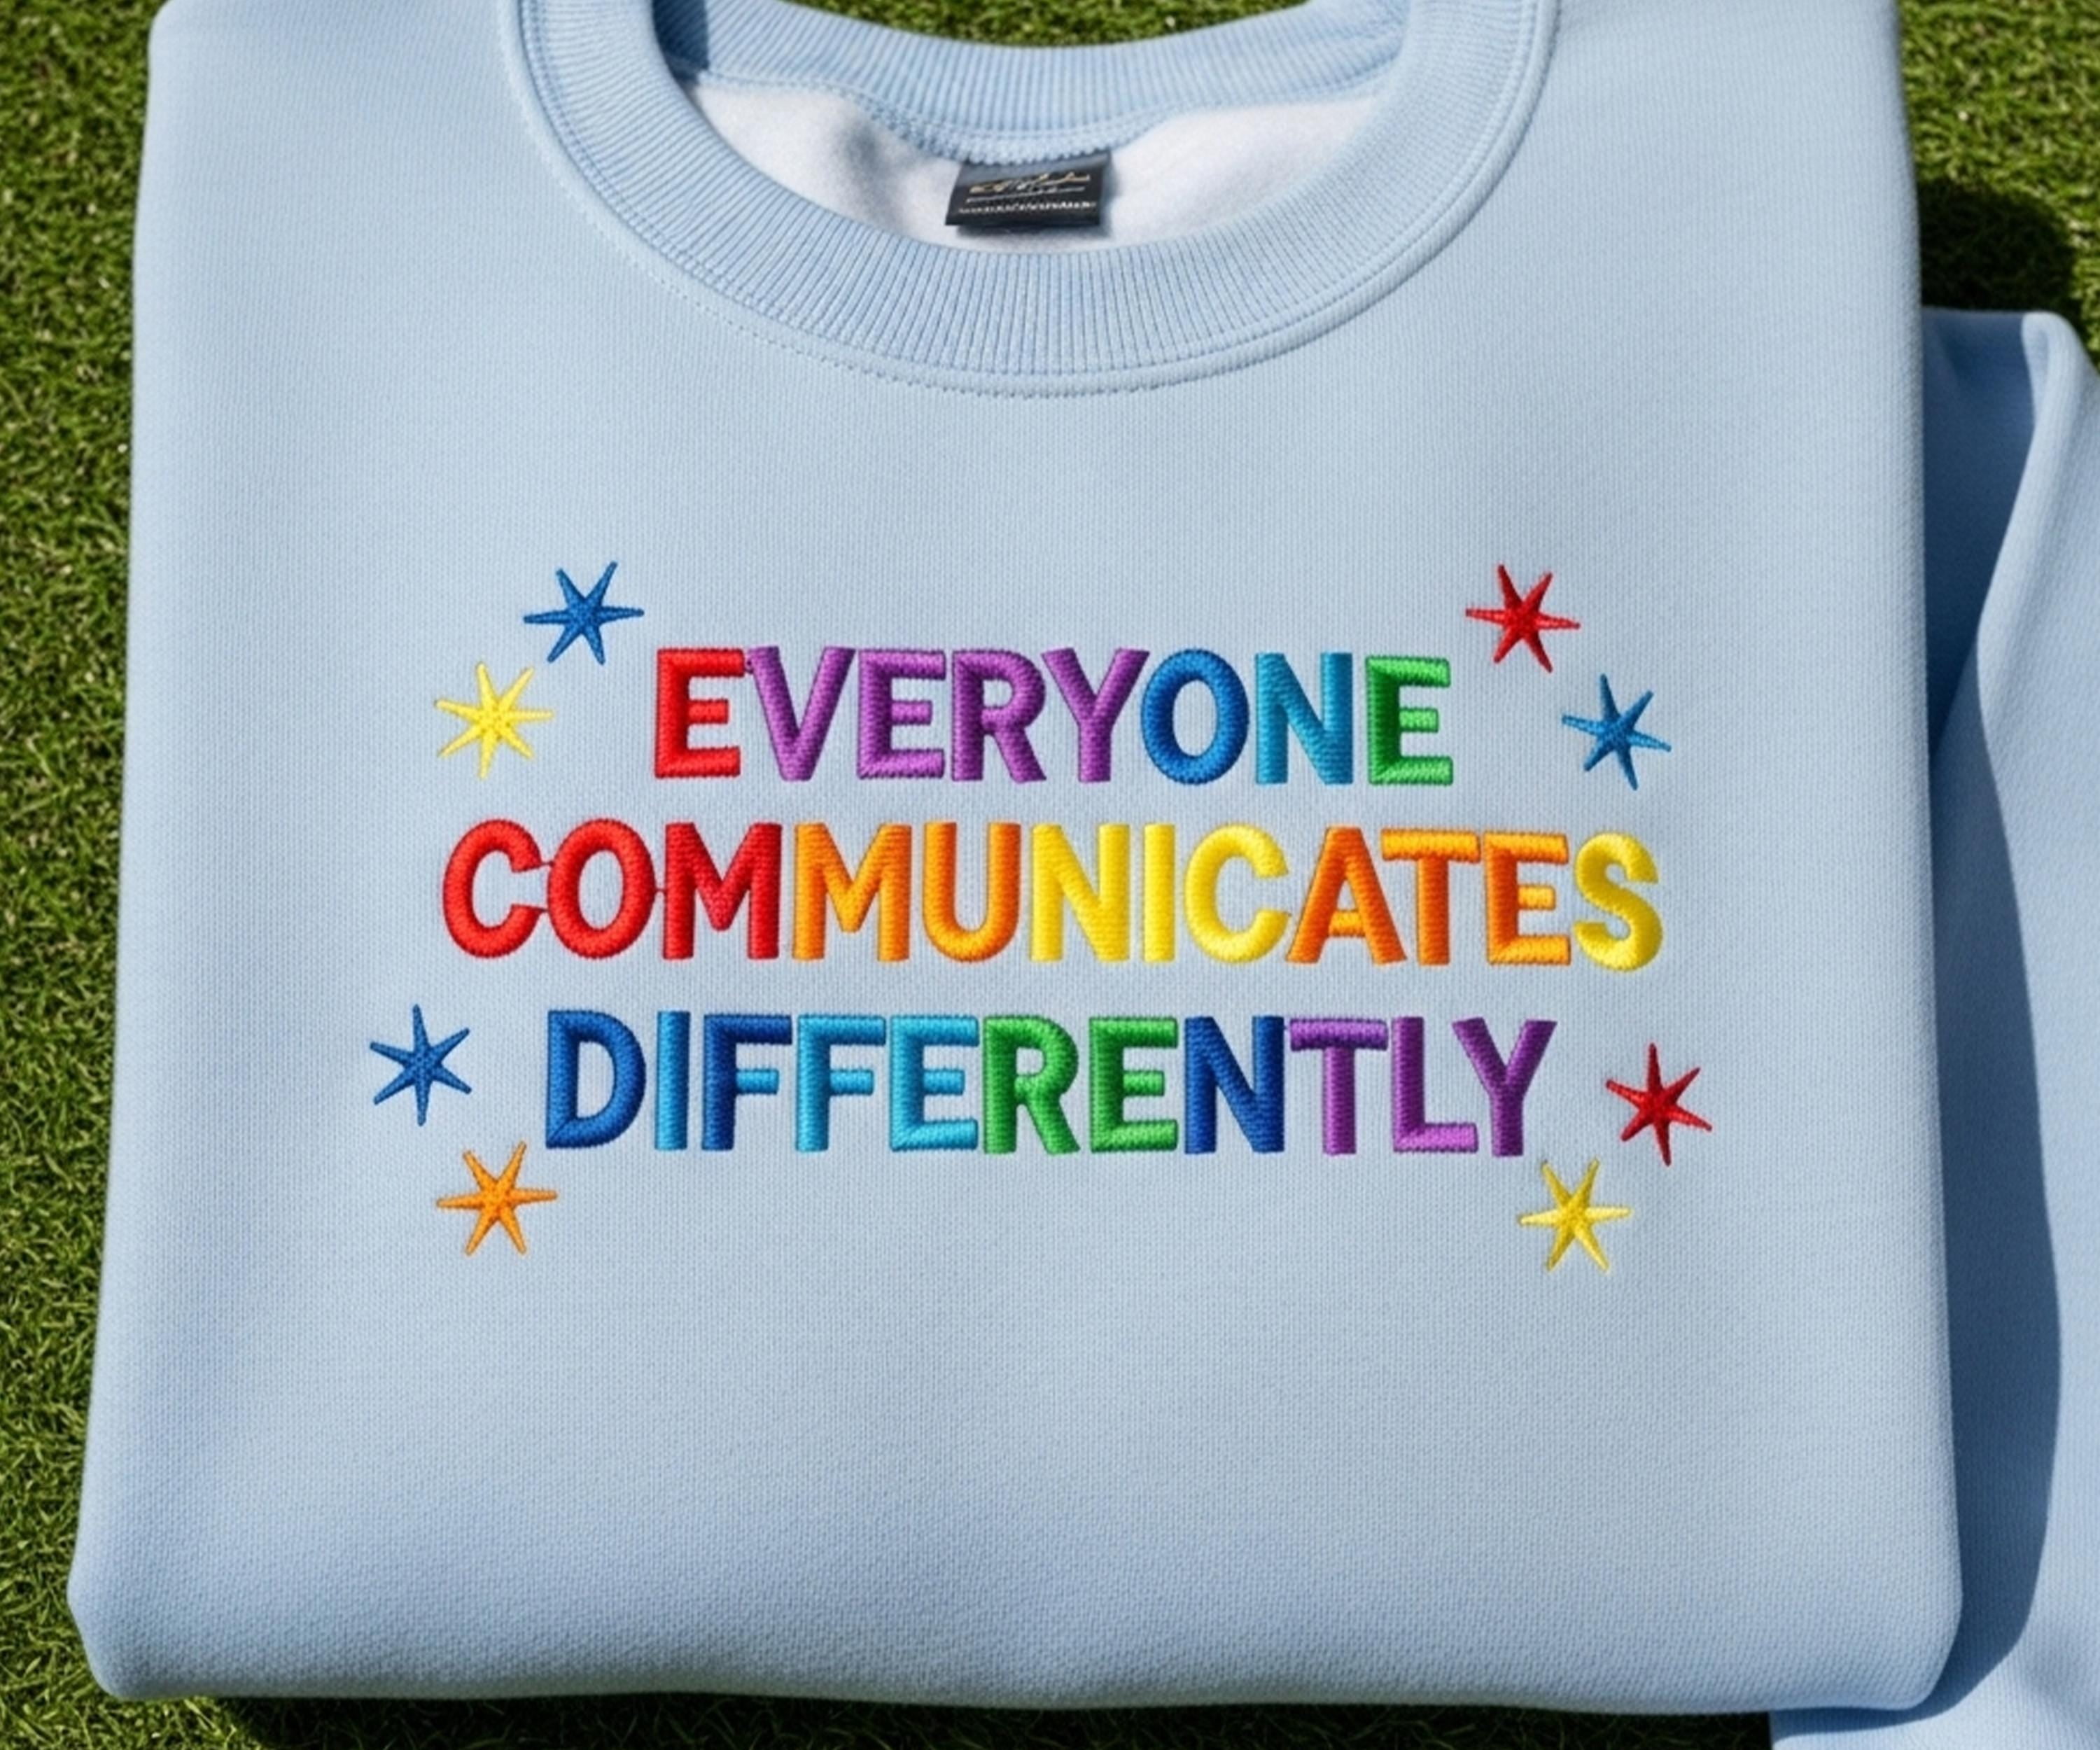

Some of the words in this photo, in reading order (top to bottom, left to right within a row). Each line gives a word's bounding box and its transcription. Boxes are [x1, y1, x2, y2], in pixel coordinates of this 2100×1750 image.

[653, 647, 1452, 785] EVERYONE
[442, 818, 1663, 971] COMMUNICATES
[545, 1009, 1556, 1156] DIFFERENTLY
